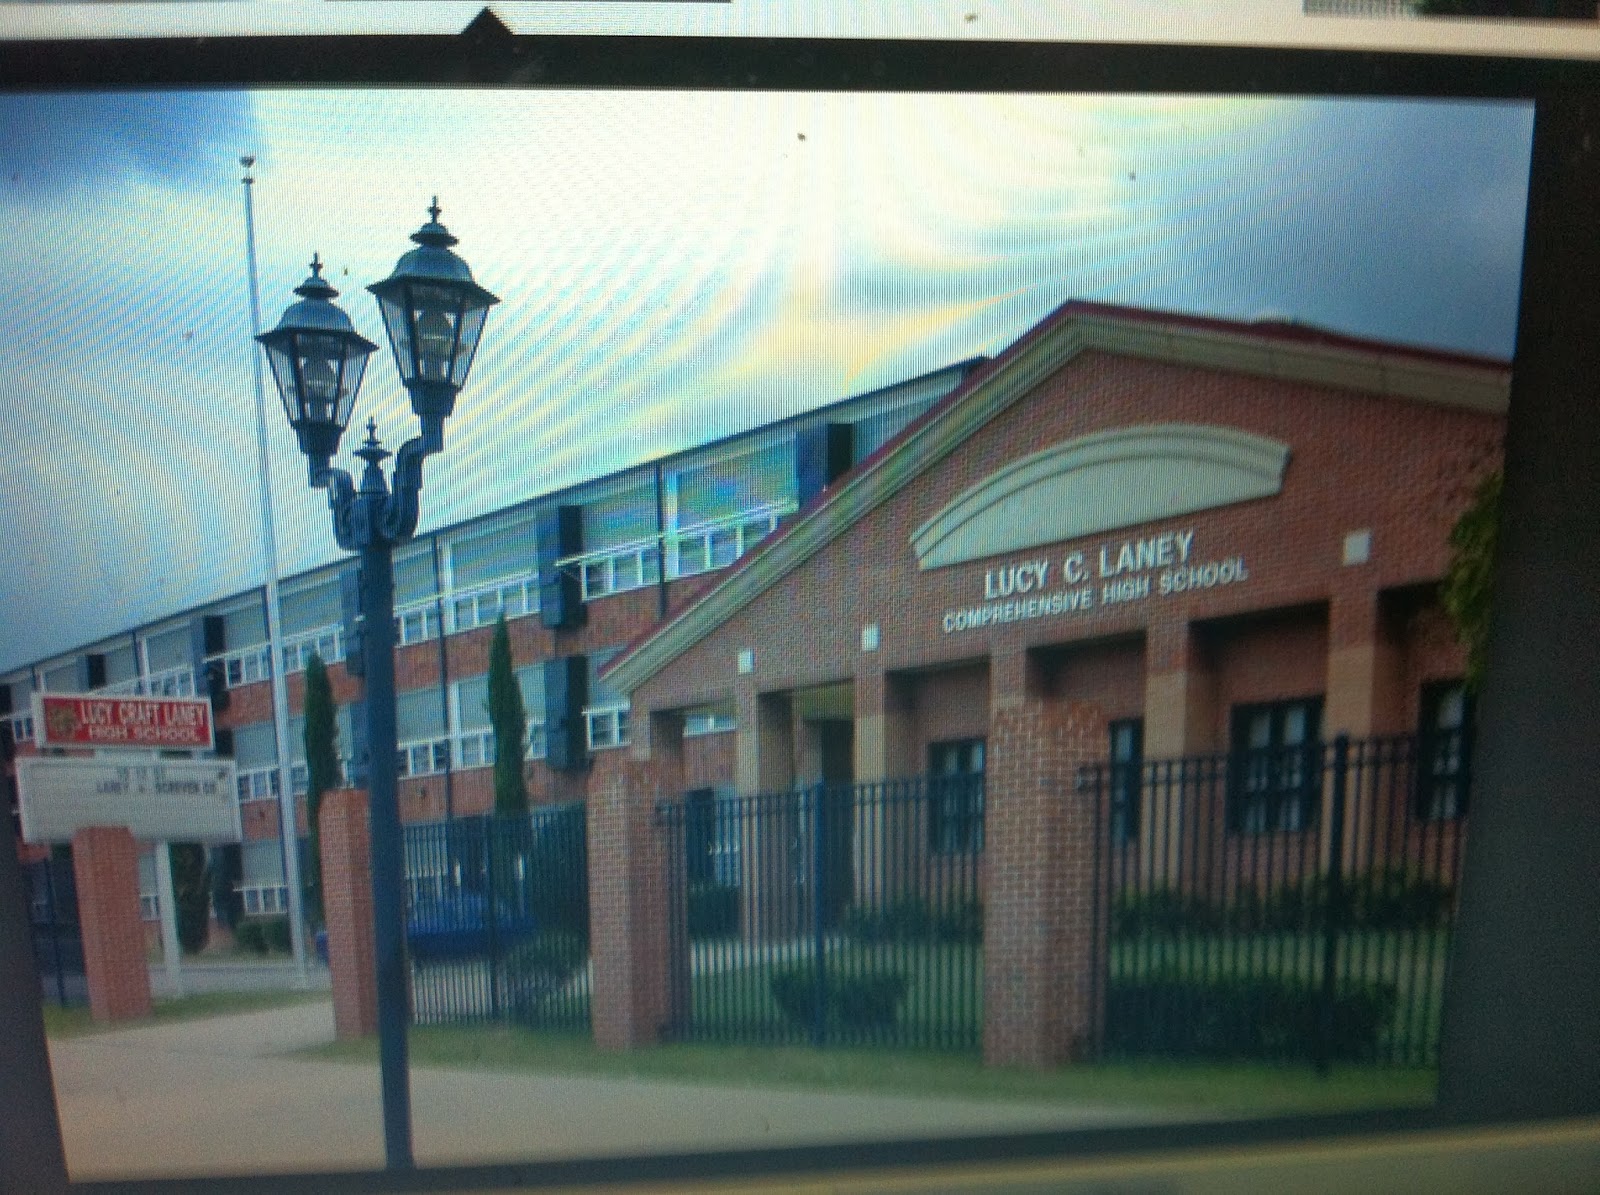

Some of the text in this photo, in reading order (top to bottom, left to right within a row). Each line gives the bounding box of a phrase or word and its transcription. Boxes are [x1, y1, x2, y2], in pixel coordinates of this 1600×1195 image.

[984, 530, 1195, 599] LUCY C. LANEY
[943, 557, 1249, 633] COMPREHENSIVE HIGH SCHOOL
[80, 700, 206, 726] LUCY CRAFT LANEY
[88, 725, 201, 742] HIGH SCHOOL
